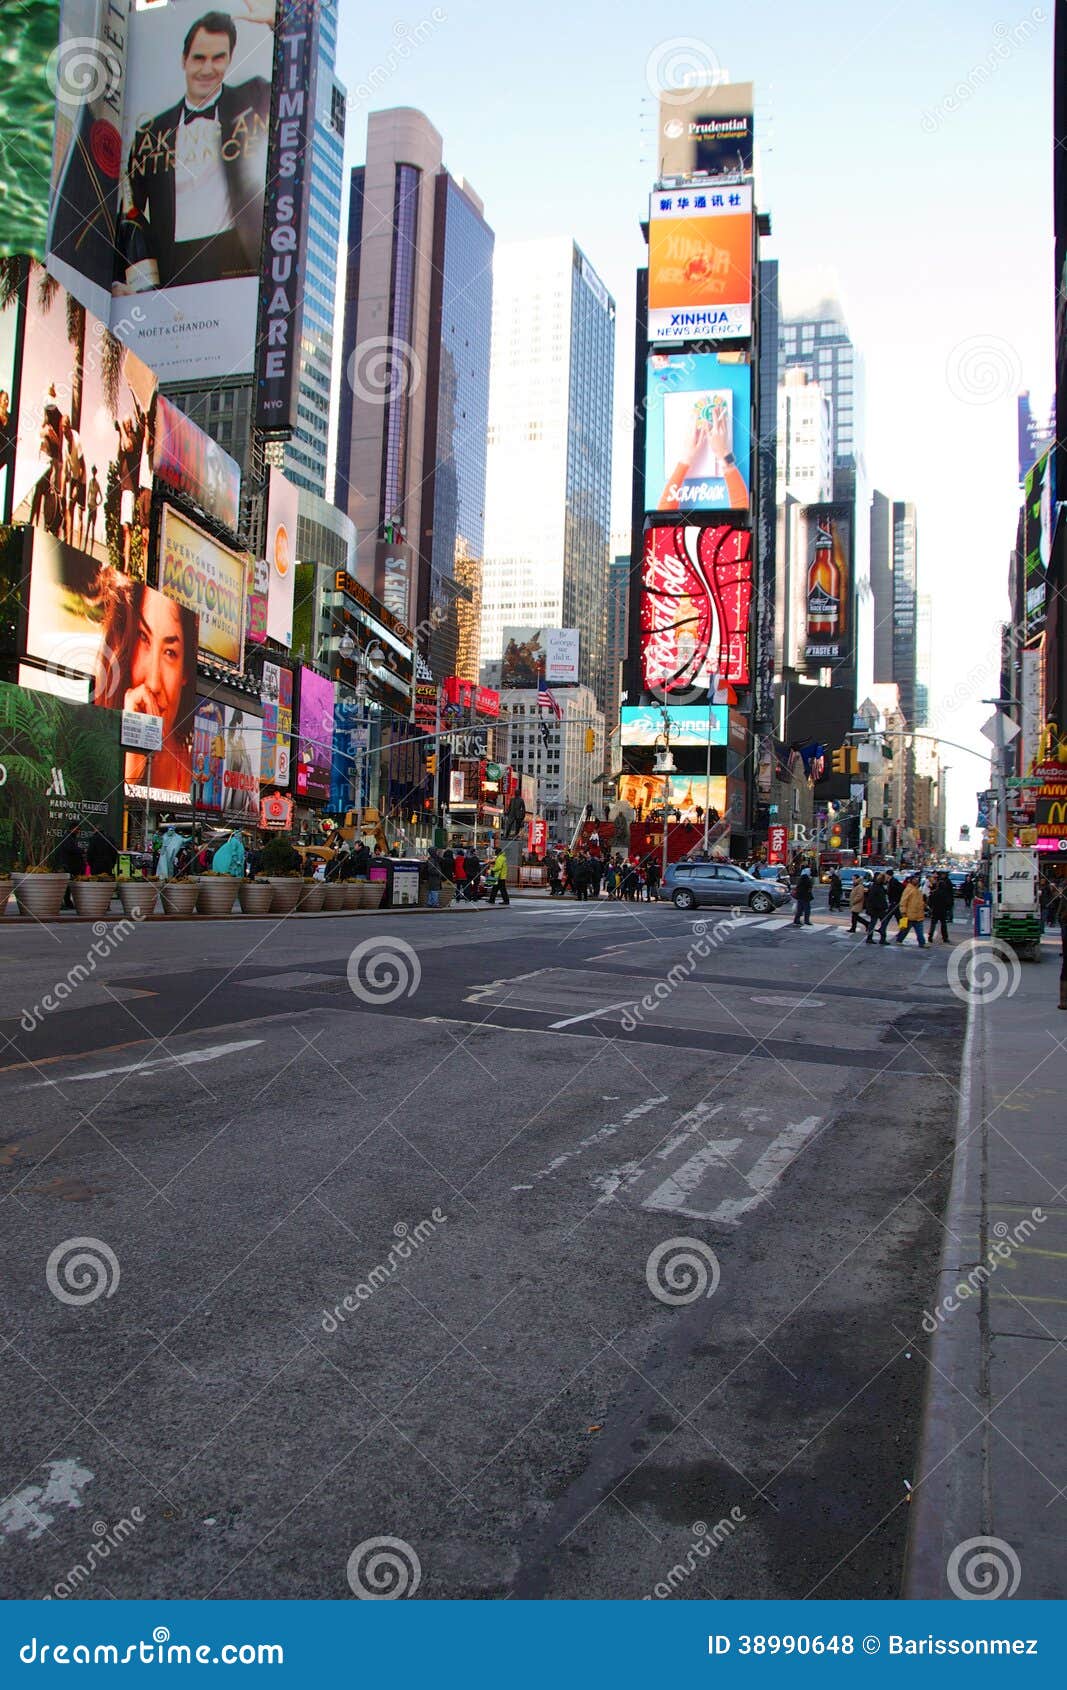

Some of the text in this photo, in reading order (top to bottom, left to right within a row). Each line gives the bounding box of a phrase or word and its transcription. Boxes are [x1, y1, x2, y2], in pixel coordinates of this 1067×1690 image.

[688, 118, 747, 134] Prudential
[266, 33, 307, 379] TIMES SQUARE
[660, 194, 741, 211] 新华通讯社
[172, 319, 220, 334] CHANDON
[671, 311, 728, 326] XINHUA
[657, 324, 743, 337] NEWS AGENCY
[263, 400, 284, 410] NYC
[163, 554, 238, 624] MOTOWN
[773, 829, 785, 851] tkts
